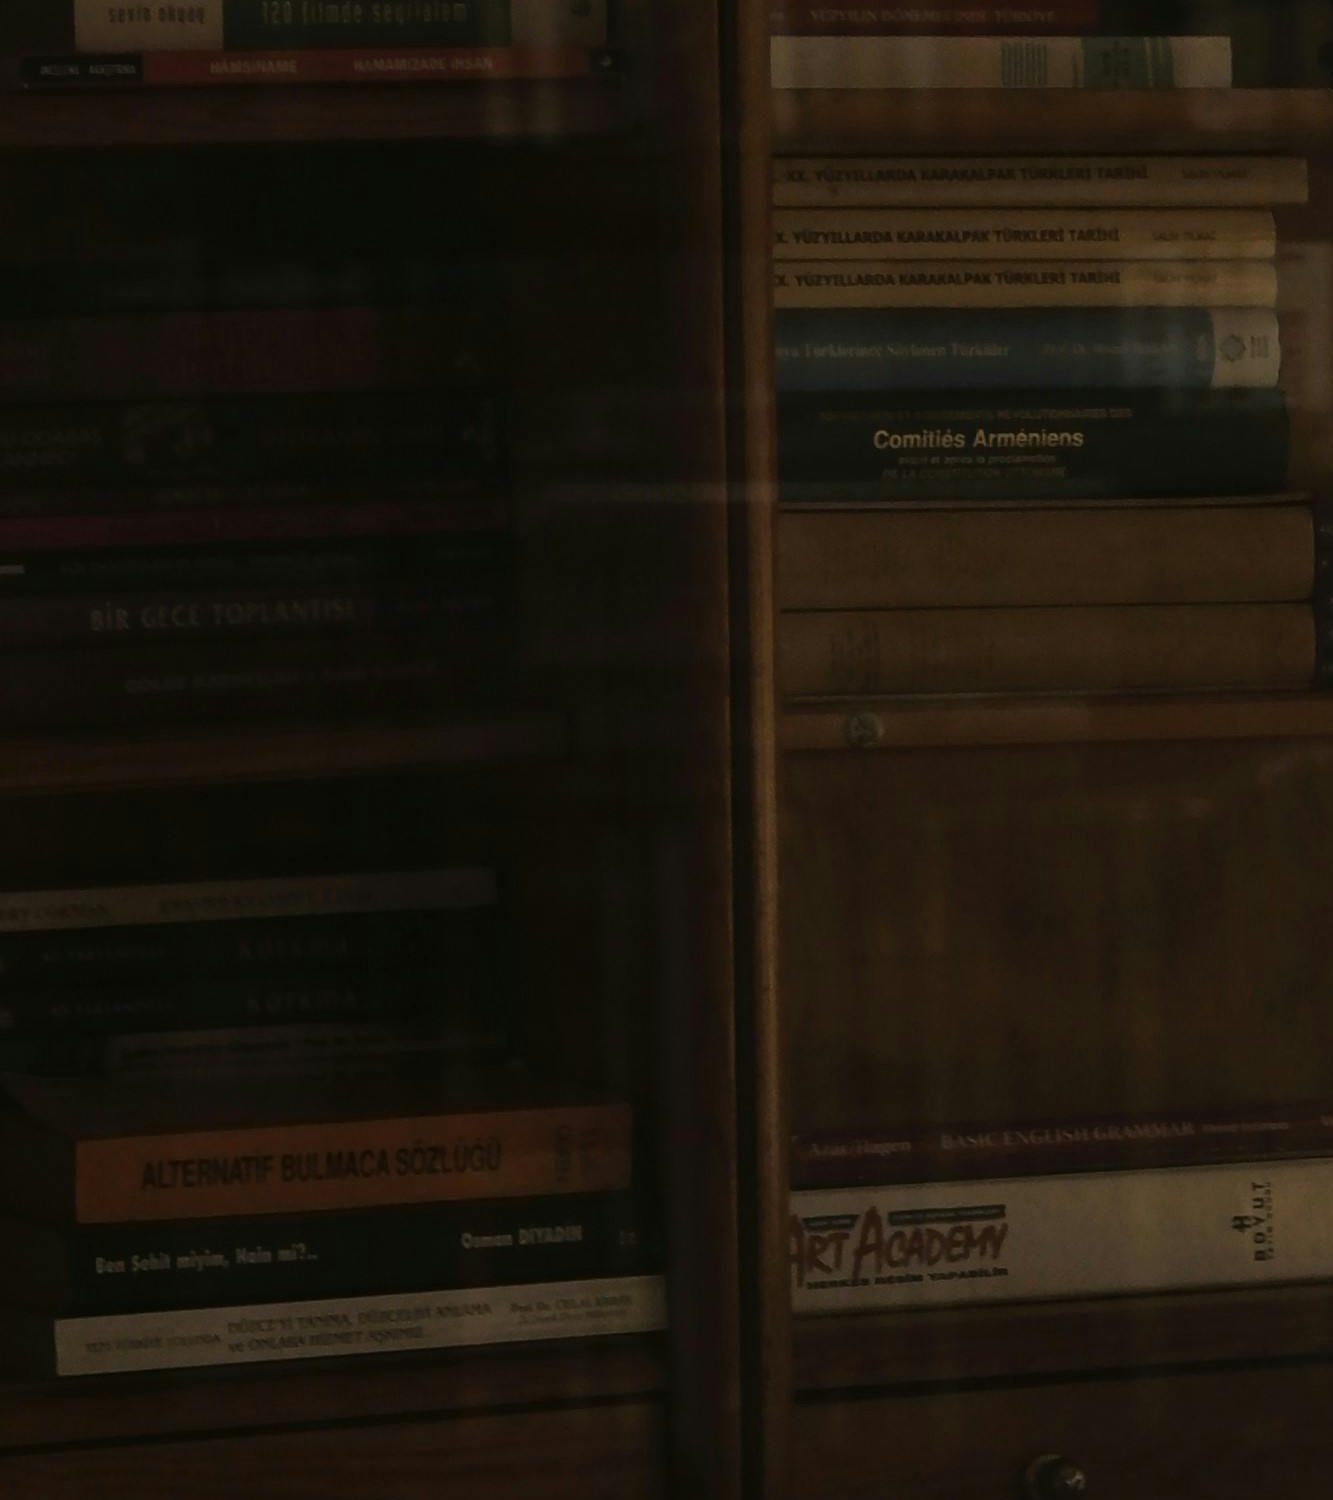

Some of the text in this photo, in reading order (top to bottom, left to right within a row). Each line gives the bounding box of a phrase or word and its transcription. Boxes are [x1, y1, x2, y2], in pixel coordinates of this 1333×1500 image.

[872, 425, 1085, 452] Comitiés Arméniens
[141, 1152, 274, 1190] ALTERNATİF
[281, 1150, 390, 1184] BULMACA
[855, 1204, 1009, 1271] ACADEMY
